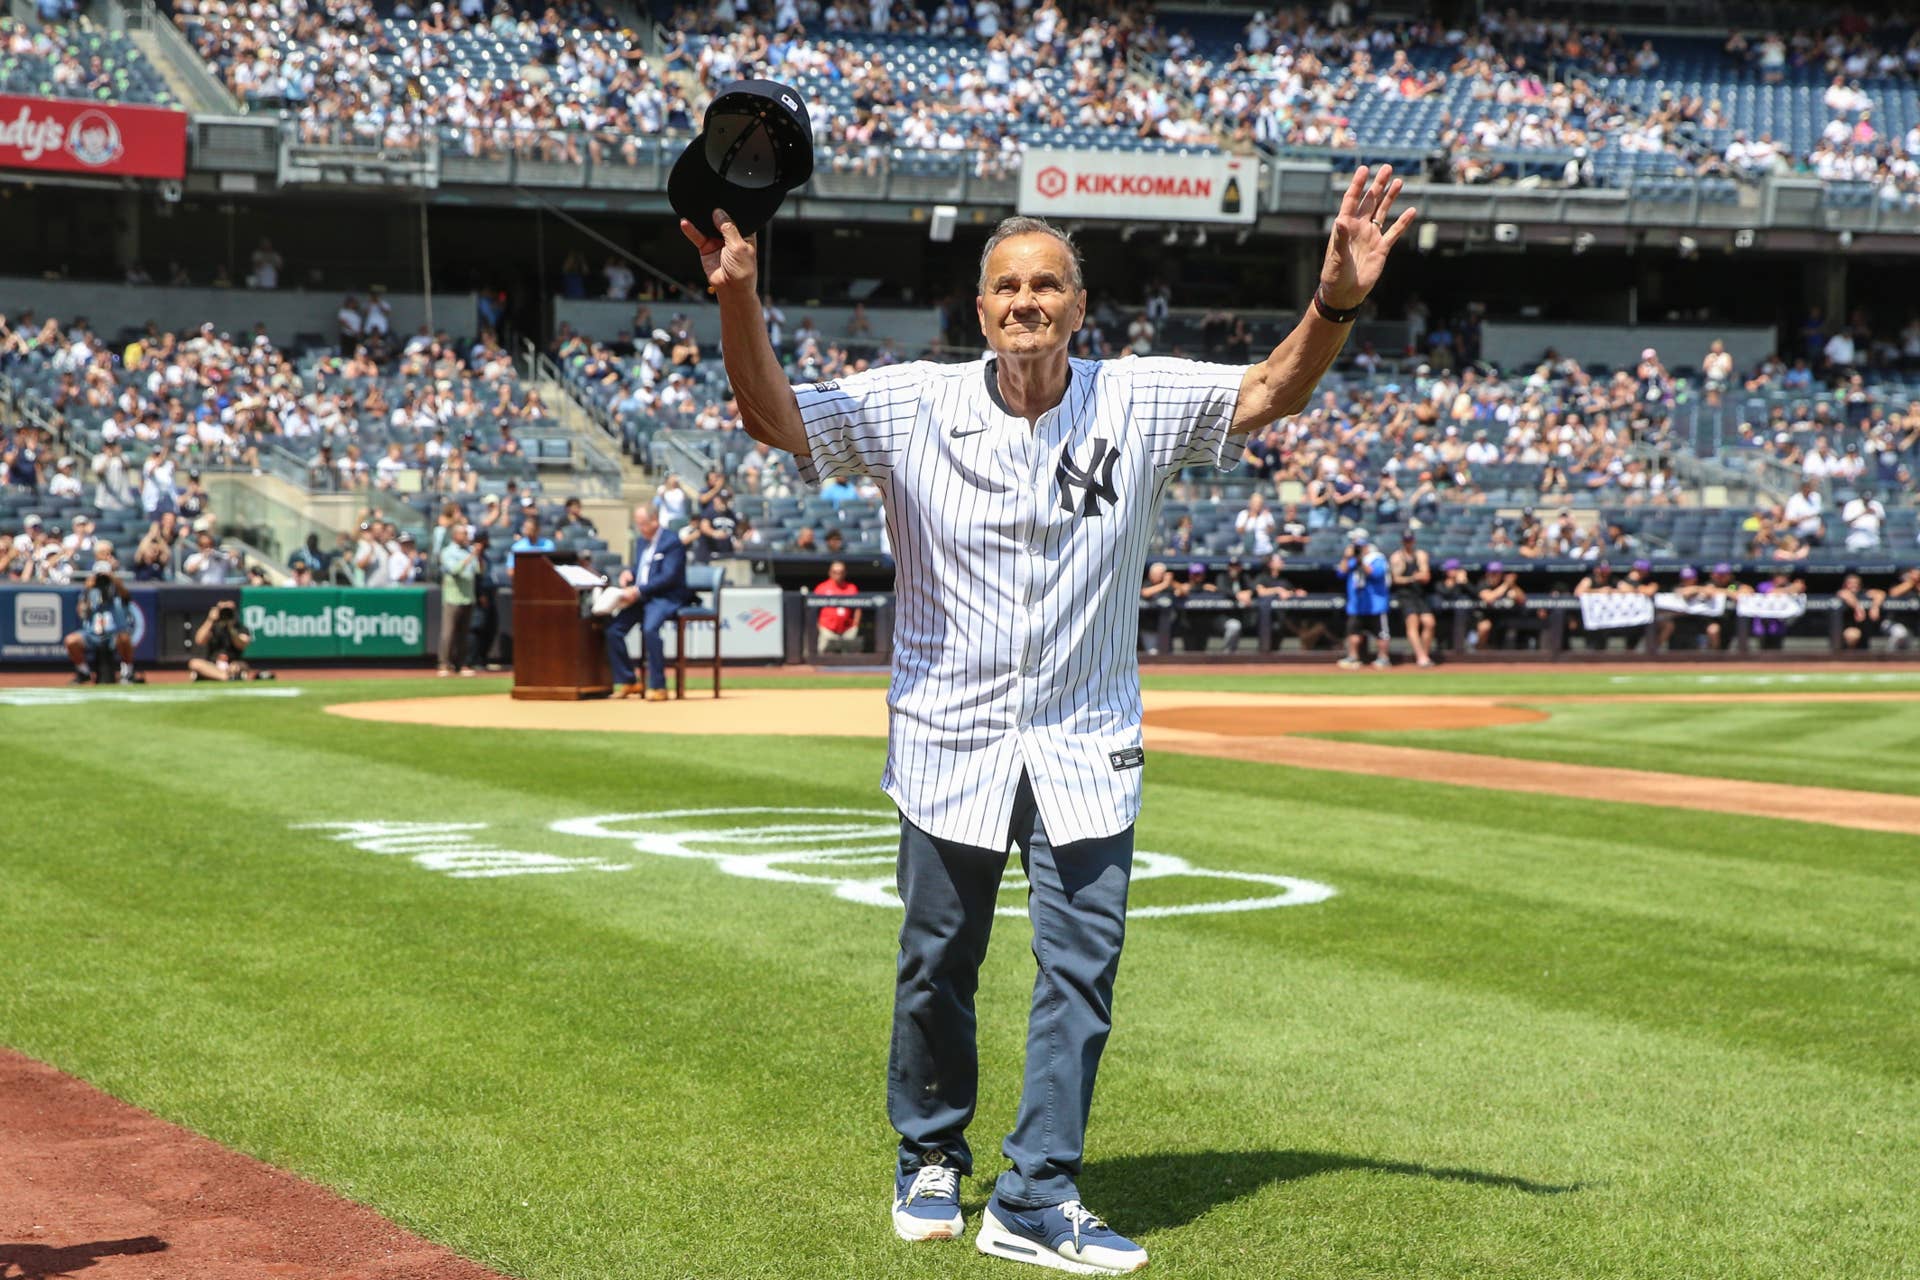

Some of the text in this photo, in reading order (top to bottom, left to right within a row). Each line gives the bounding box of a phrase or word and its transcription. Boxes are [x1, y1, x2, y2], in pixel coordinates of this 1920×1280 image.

[1076, 173, 1212, 198] KIKKOMAN
[1055, 437, 1121, 517] NY
[243, 605, 421, 645] Poland Spring
